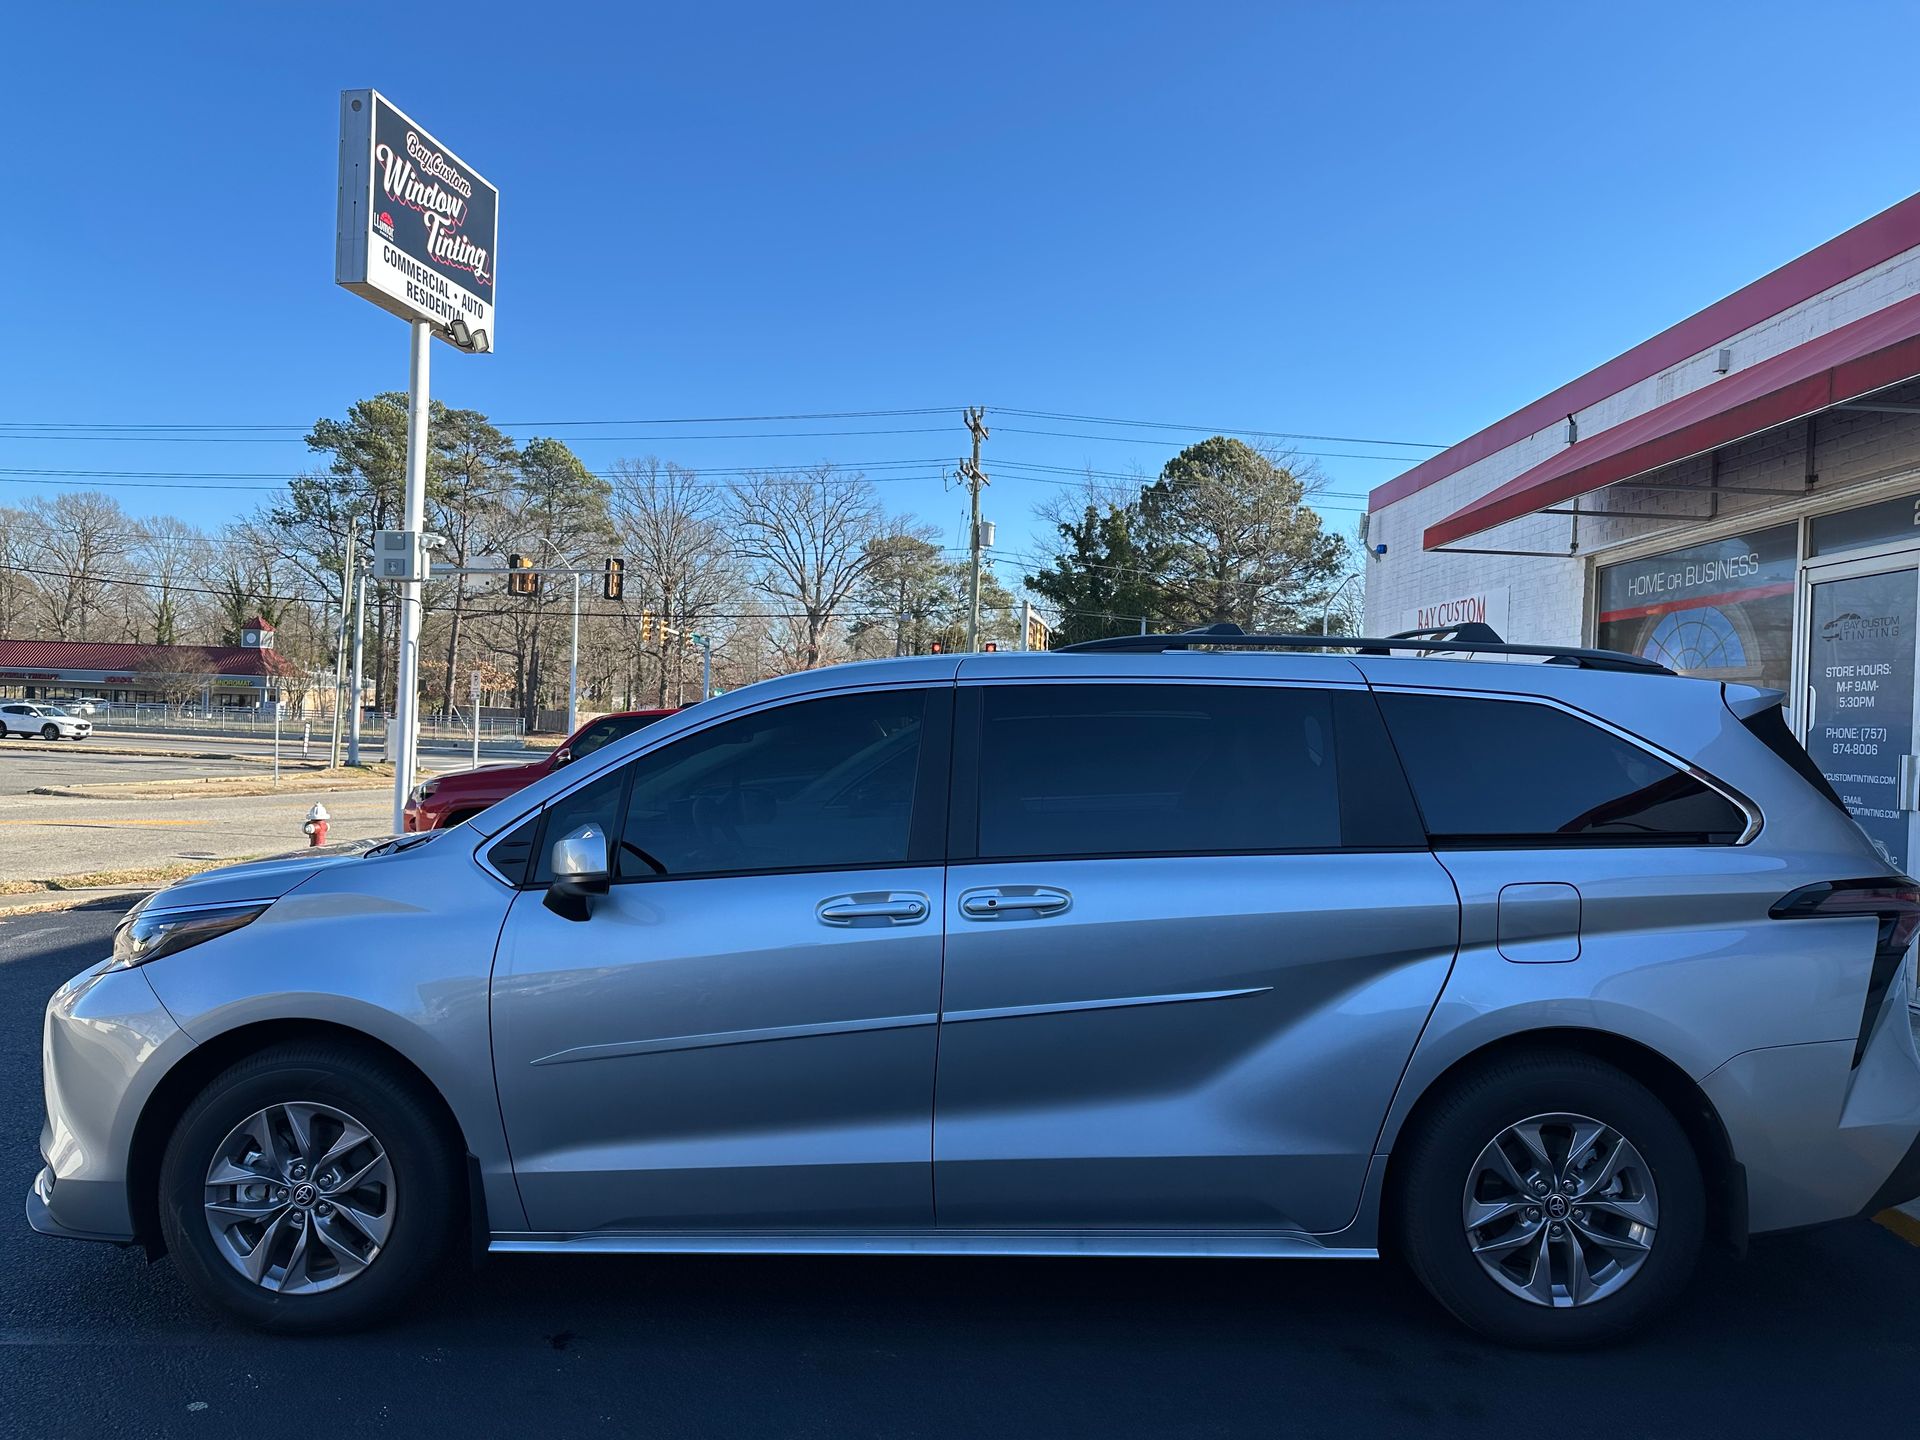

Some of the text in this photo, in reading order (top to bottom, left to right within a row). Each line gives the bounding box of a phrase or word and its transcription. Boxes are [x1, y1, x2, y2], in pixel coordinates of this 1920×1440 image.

[406, 131, 472, 199] Bay Custom
[376, 144, 465, 220] Window
[424, 210, 490, 281] Tinting
[383, 245, 484, 319] COMMERCIAL AUTO
[1628, 553, 1759, 597] HOME OR BUSINESS
[1438, 594, 1486, 627] CUSTOM
[1843, 616, 1900, 631] BAY CUSTOM
[1844, 626, 1899, 640] TINTING
[1825, 663, 1892, 678] STORE HOURS:
[1836, 680, 1879, 693] M-F 9AM-
[1839, 696, 1875, 708] 5:30PM
[1826, 727, 1887, 742] PHONE: (757)
[1832, 743, 1878, 755] 874-8006
[1843, 795, 1863, 805] EMAIL
